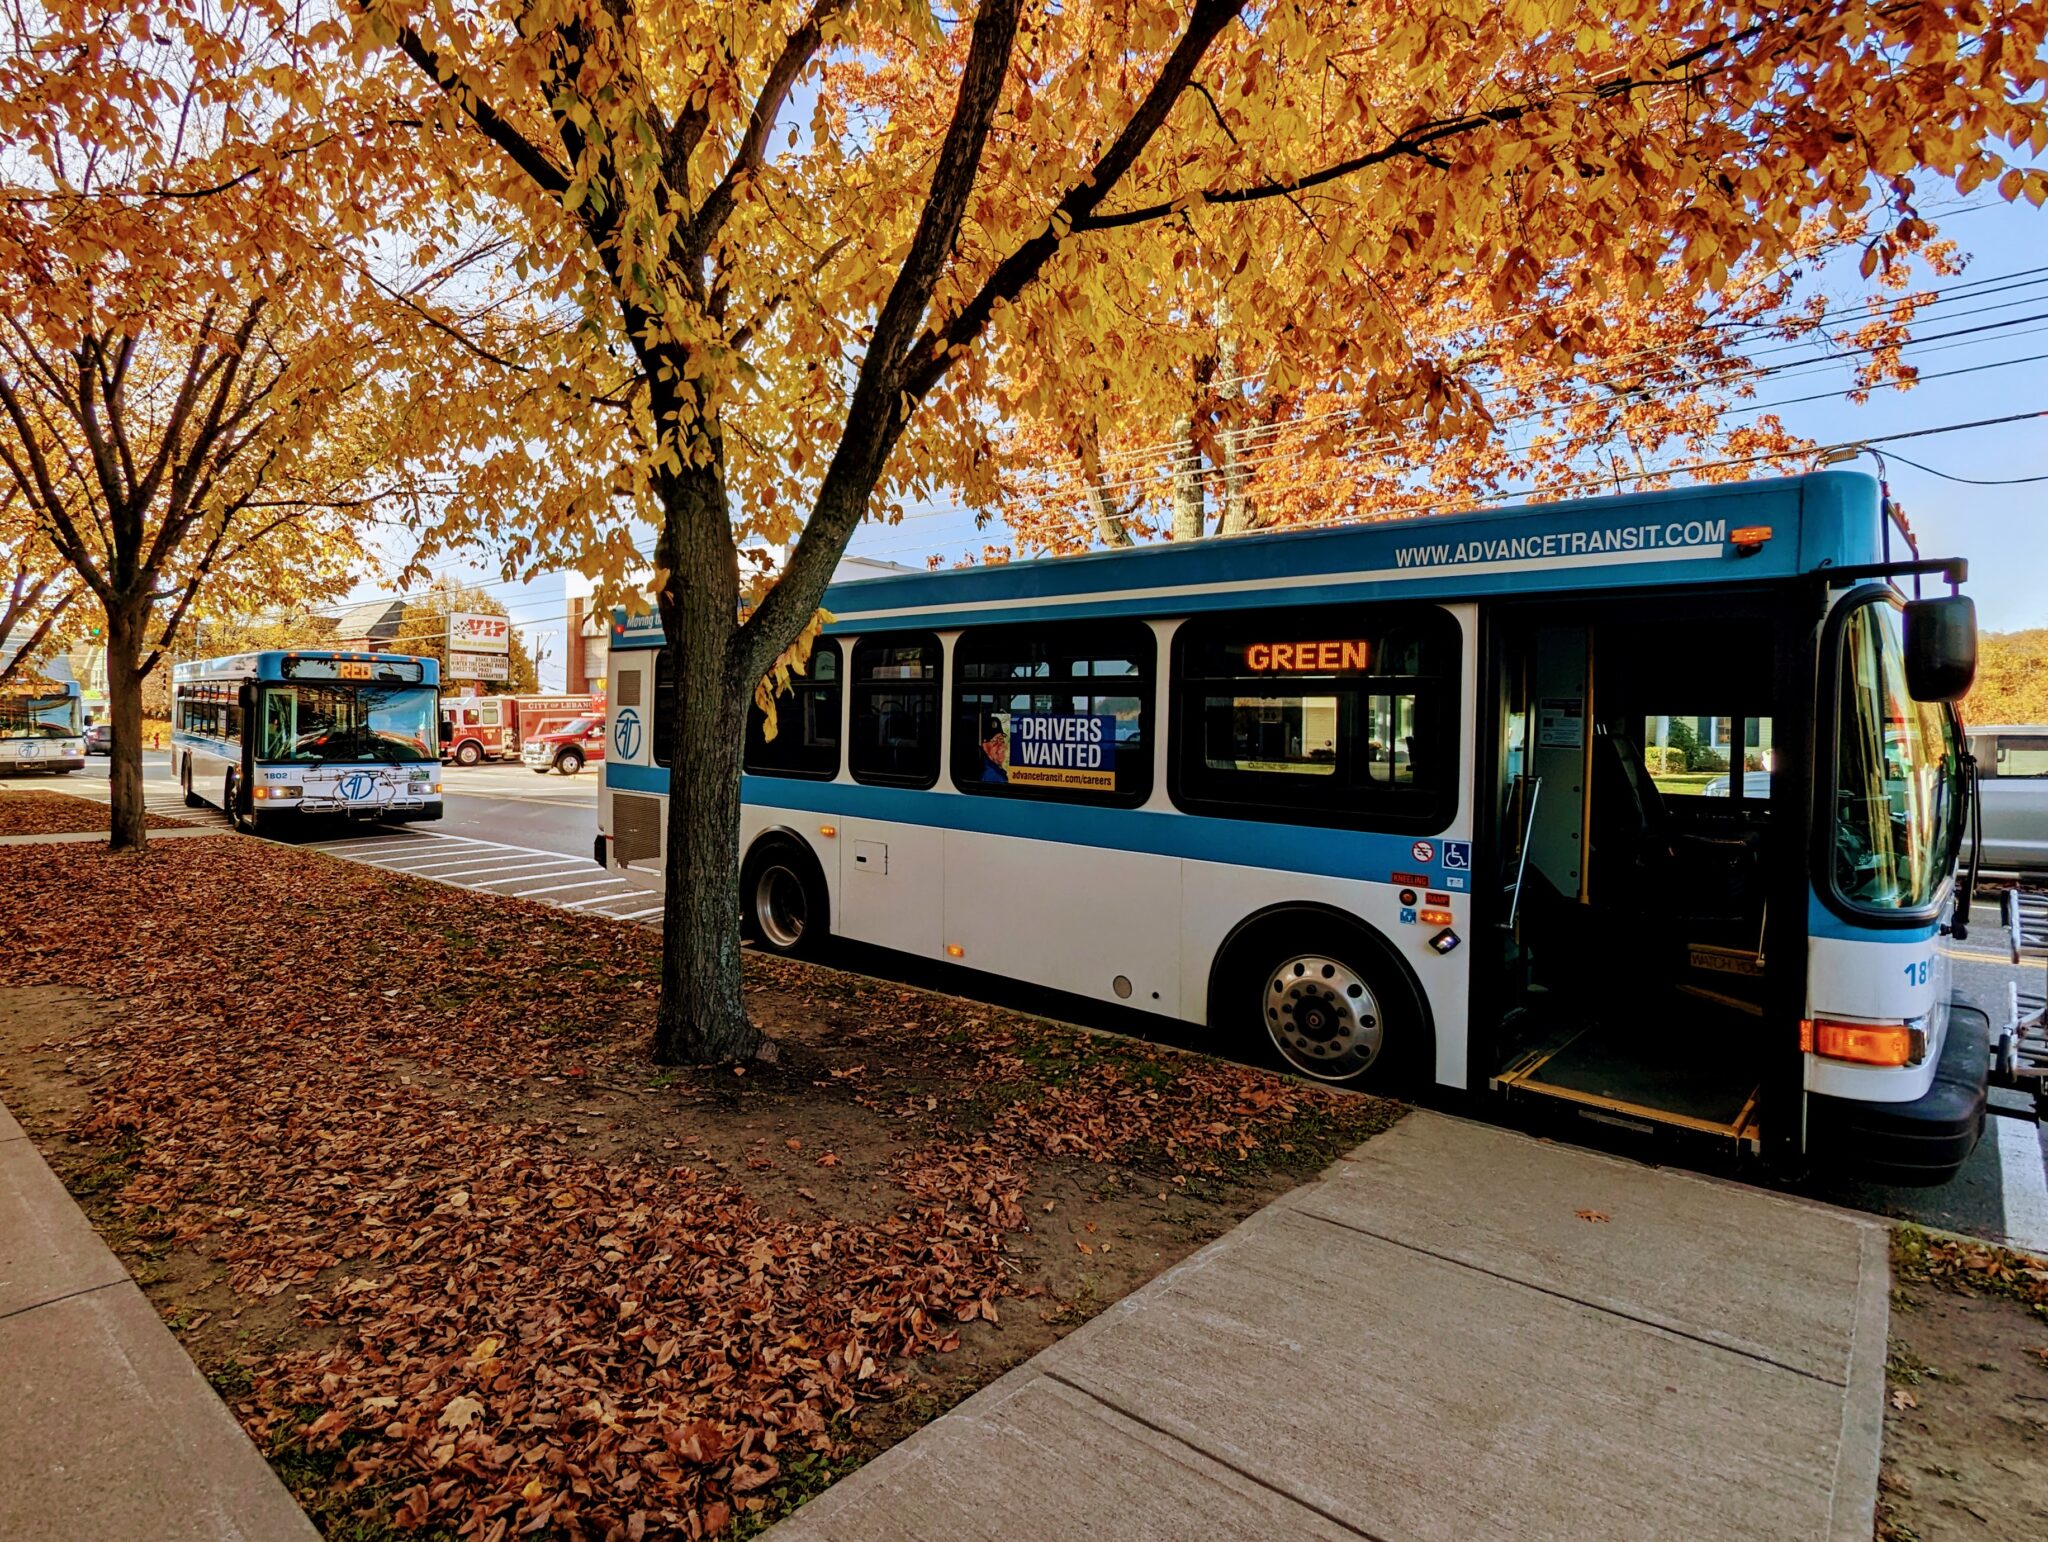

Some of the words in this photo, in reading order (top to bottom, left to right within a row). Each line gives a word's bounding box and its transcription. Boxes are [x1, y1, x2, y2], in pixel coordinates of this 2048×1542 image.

[1395, 519, 1726, 568] WWW.ADVANCETRANSIT.COM
[468, 619, 506, 637] VIP
[626, 615, 654, 630] Moving
[1248, 642, 1366, 670] GREEN
[340, 663, 372, 679] RED
[1022, 717, 1102, 743] DRIVERS
[1021, 741, 1101, 768] WANTED
[264, 772, 288, 780] 1802
[1011, 770, 1112, 787] advancetransit.com/careers
[1393, 874, 1427, 885] KNEELING
[1427, 894, 1448, 904] RAMP
[1691, 952, 1732, 970] WATCH
